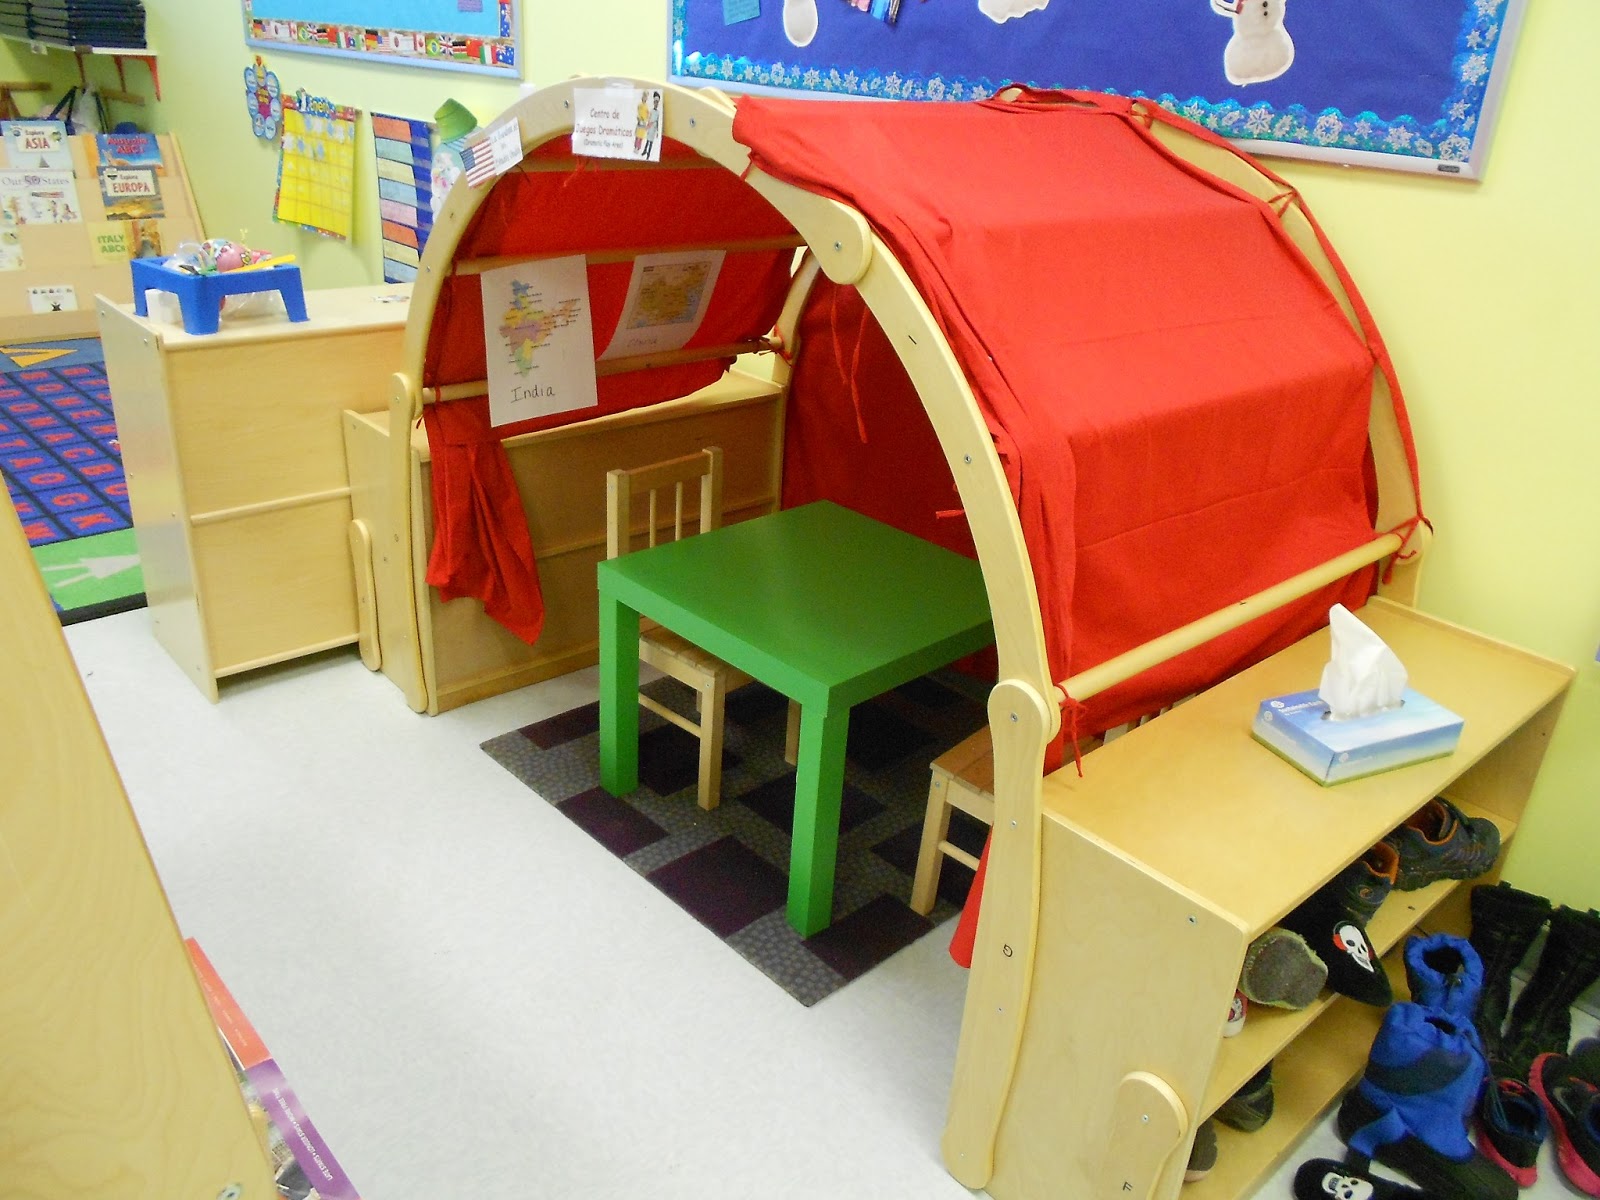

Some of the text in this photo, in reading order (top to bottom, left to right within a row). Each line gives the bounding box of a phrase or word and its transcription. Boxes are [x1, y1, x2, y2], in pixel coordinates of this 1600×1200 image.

[590, 108, 620, 120] Centro de
[25, 138, 51, 149] ASIA
[2, 176, 22, 186] Our
[42, 176, 70, 186] States
[112, 182, 151, 193] EUROPA
[97, 234, 125, 244] ITALY
[101, 244, 126, 253] ABCs
[511, 385, 556, 403] India
[313, 1154, 327, 1171] STARTS
[322, 1168, 334, 1181] LATE
